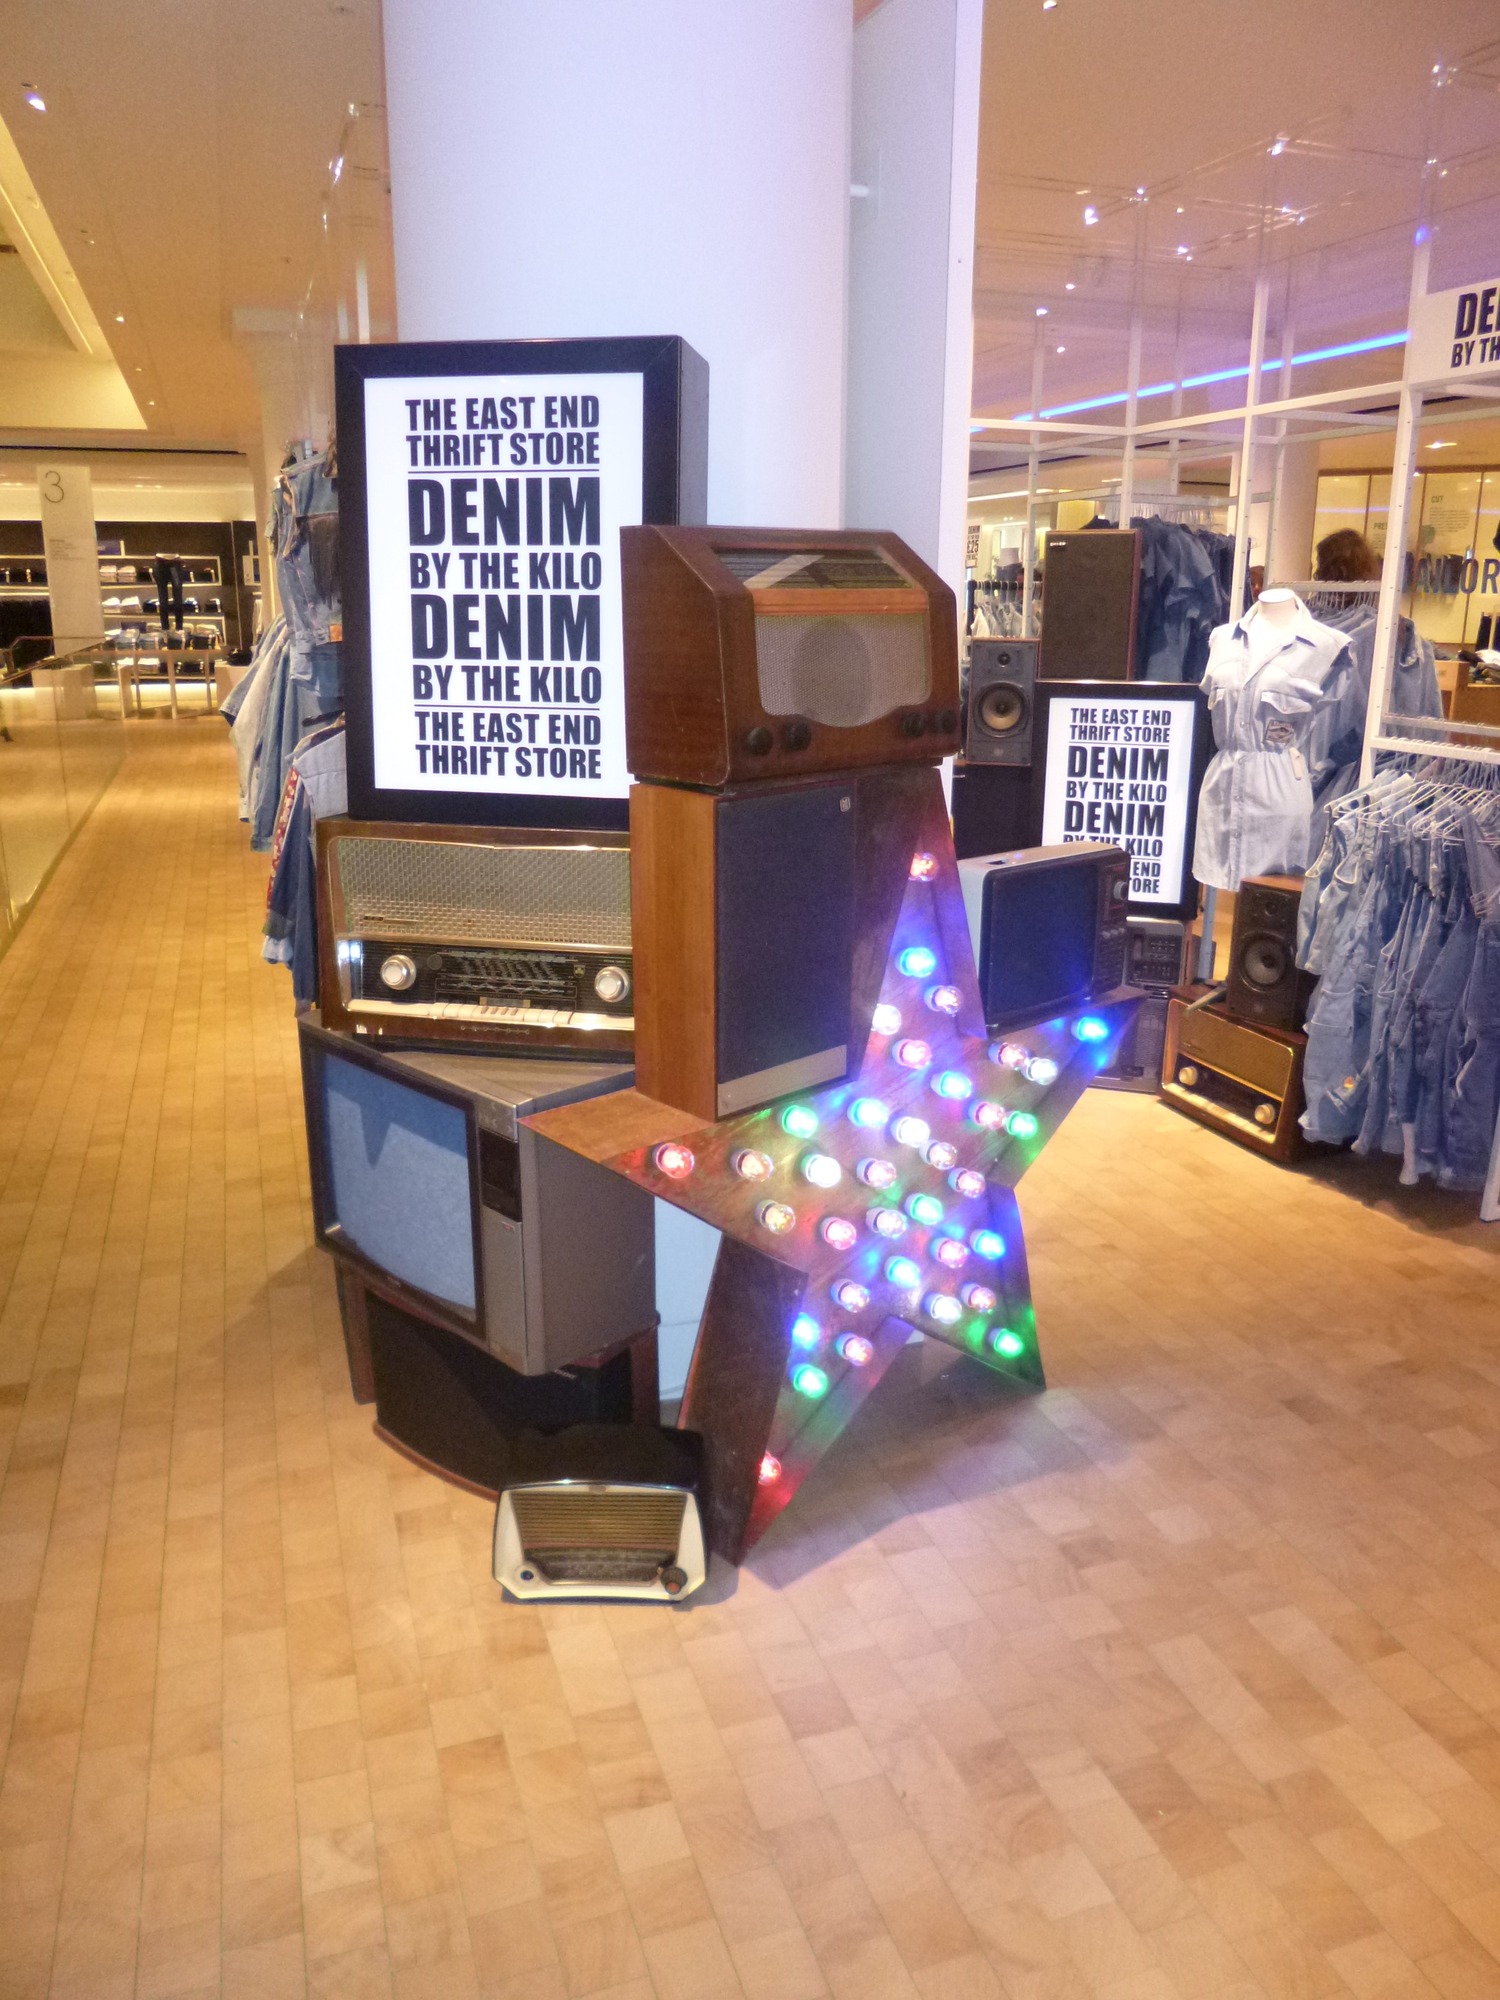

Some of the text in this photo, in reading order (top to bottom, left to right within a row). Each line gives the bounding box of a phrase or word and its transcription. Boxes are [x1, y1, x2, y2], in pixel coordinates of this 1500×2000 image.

[1454, 287, 1500, 339] DE
[1450, 341, 1475, 368] BY
[405, 395, 600, 431] THE EAST END
[406, 432, 600, 467] THRIFT STORE
[45, 470, 65, 503] 3
[408, 477, 601, 546] DENIM
[410, 552, 602, 590] BY THE KILO
[411, 594, 601, 662] DENIM
[413, 664, 602, 704] BY THE KILO
[415, 711, 601, 746] THE EAST END
[1069, 724, 1170, 743] THRIFT STORE
[1070, 707, 1172, 726] THE EAST END
[416, 744, 602, 780] THRIFT STORE
[1067, 745, 1170, 782] DENIM
[1066, 780, 1168, 803] BY THE KILO
[1064, 800, 1166, 837] DENIM
[1125, 838, 1163, 857] KILO
[1129, 877, 1160, 894] ORE
[1133, 861, 1161, 878] END
